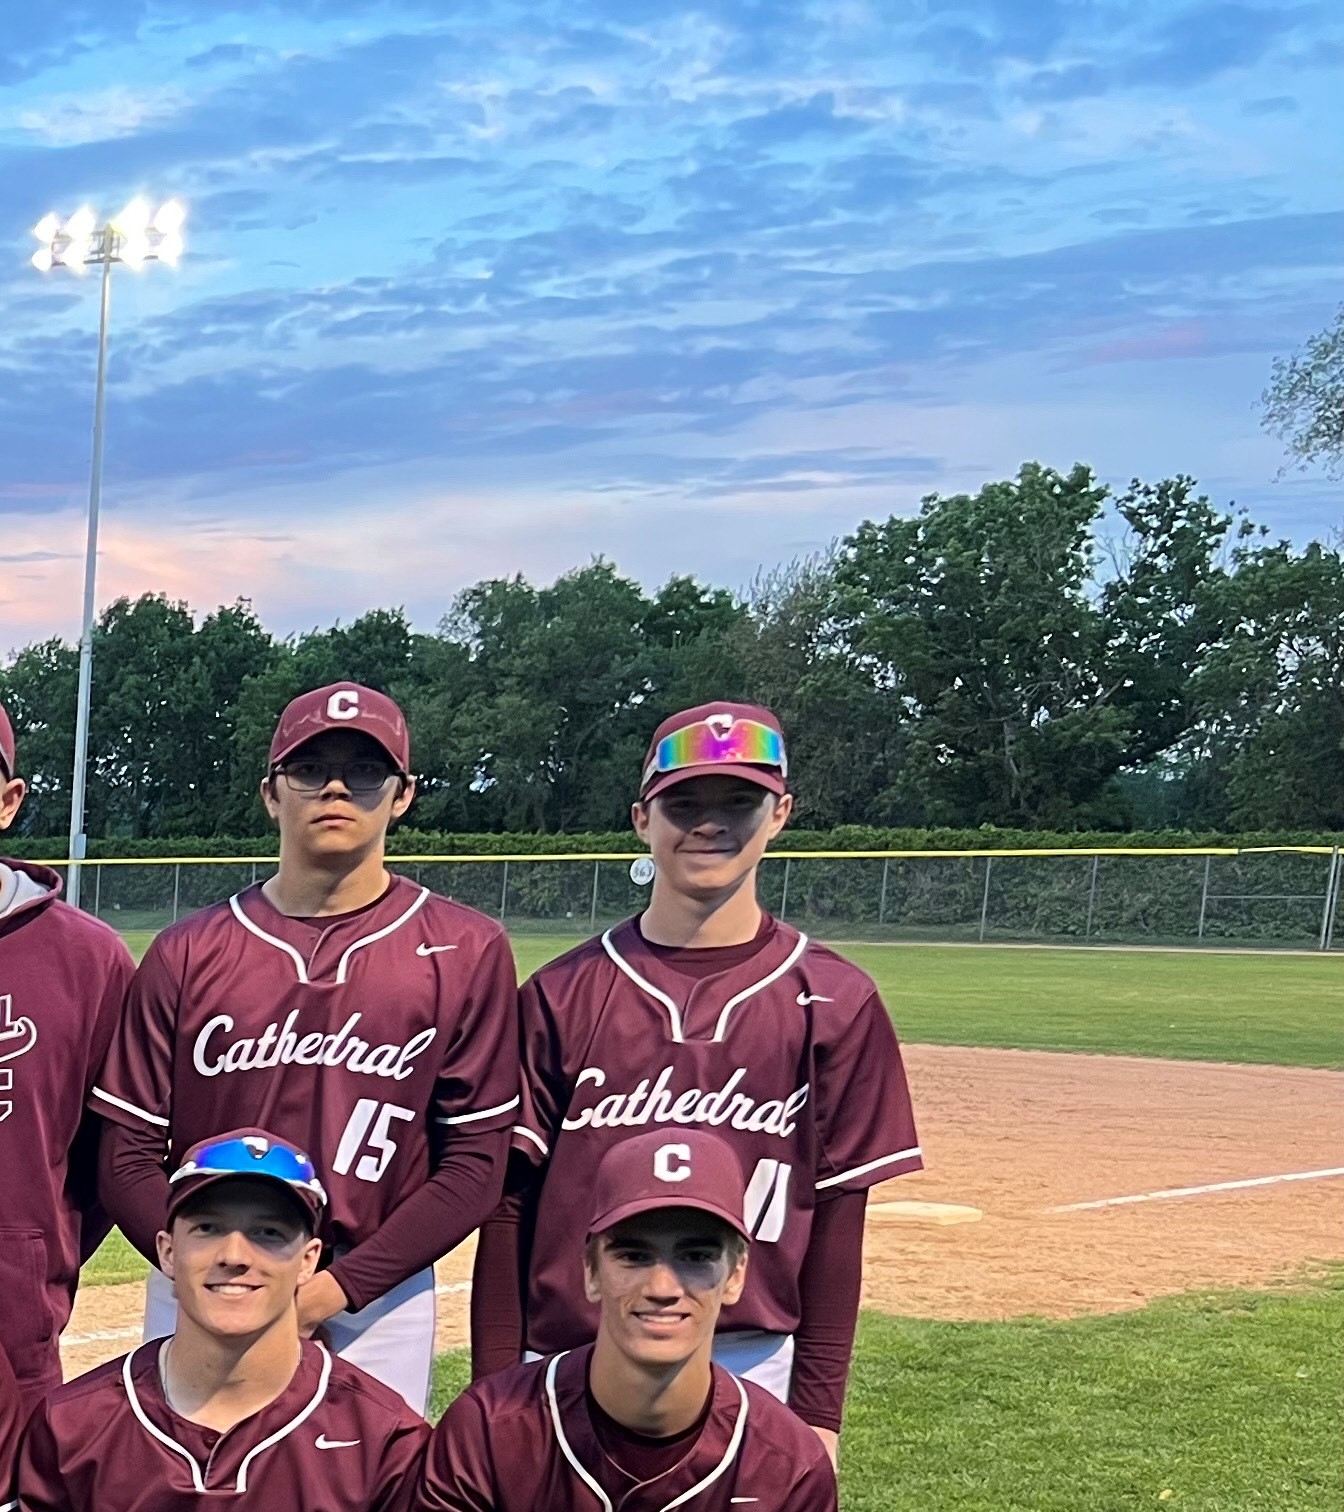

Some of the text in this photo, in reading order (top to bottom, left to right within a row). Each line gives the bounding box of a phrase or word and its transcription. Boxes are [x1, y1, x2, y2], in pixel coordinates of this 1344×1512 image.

[326, 690, 360, 721] C
[194, 1009, 437, 1081] Cathedral
[333, 1098, 416, 1183] 15
[653, 1143, 692, 1182] C
